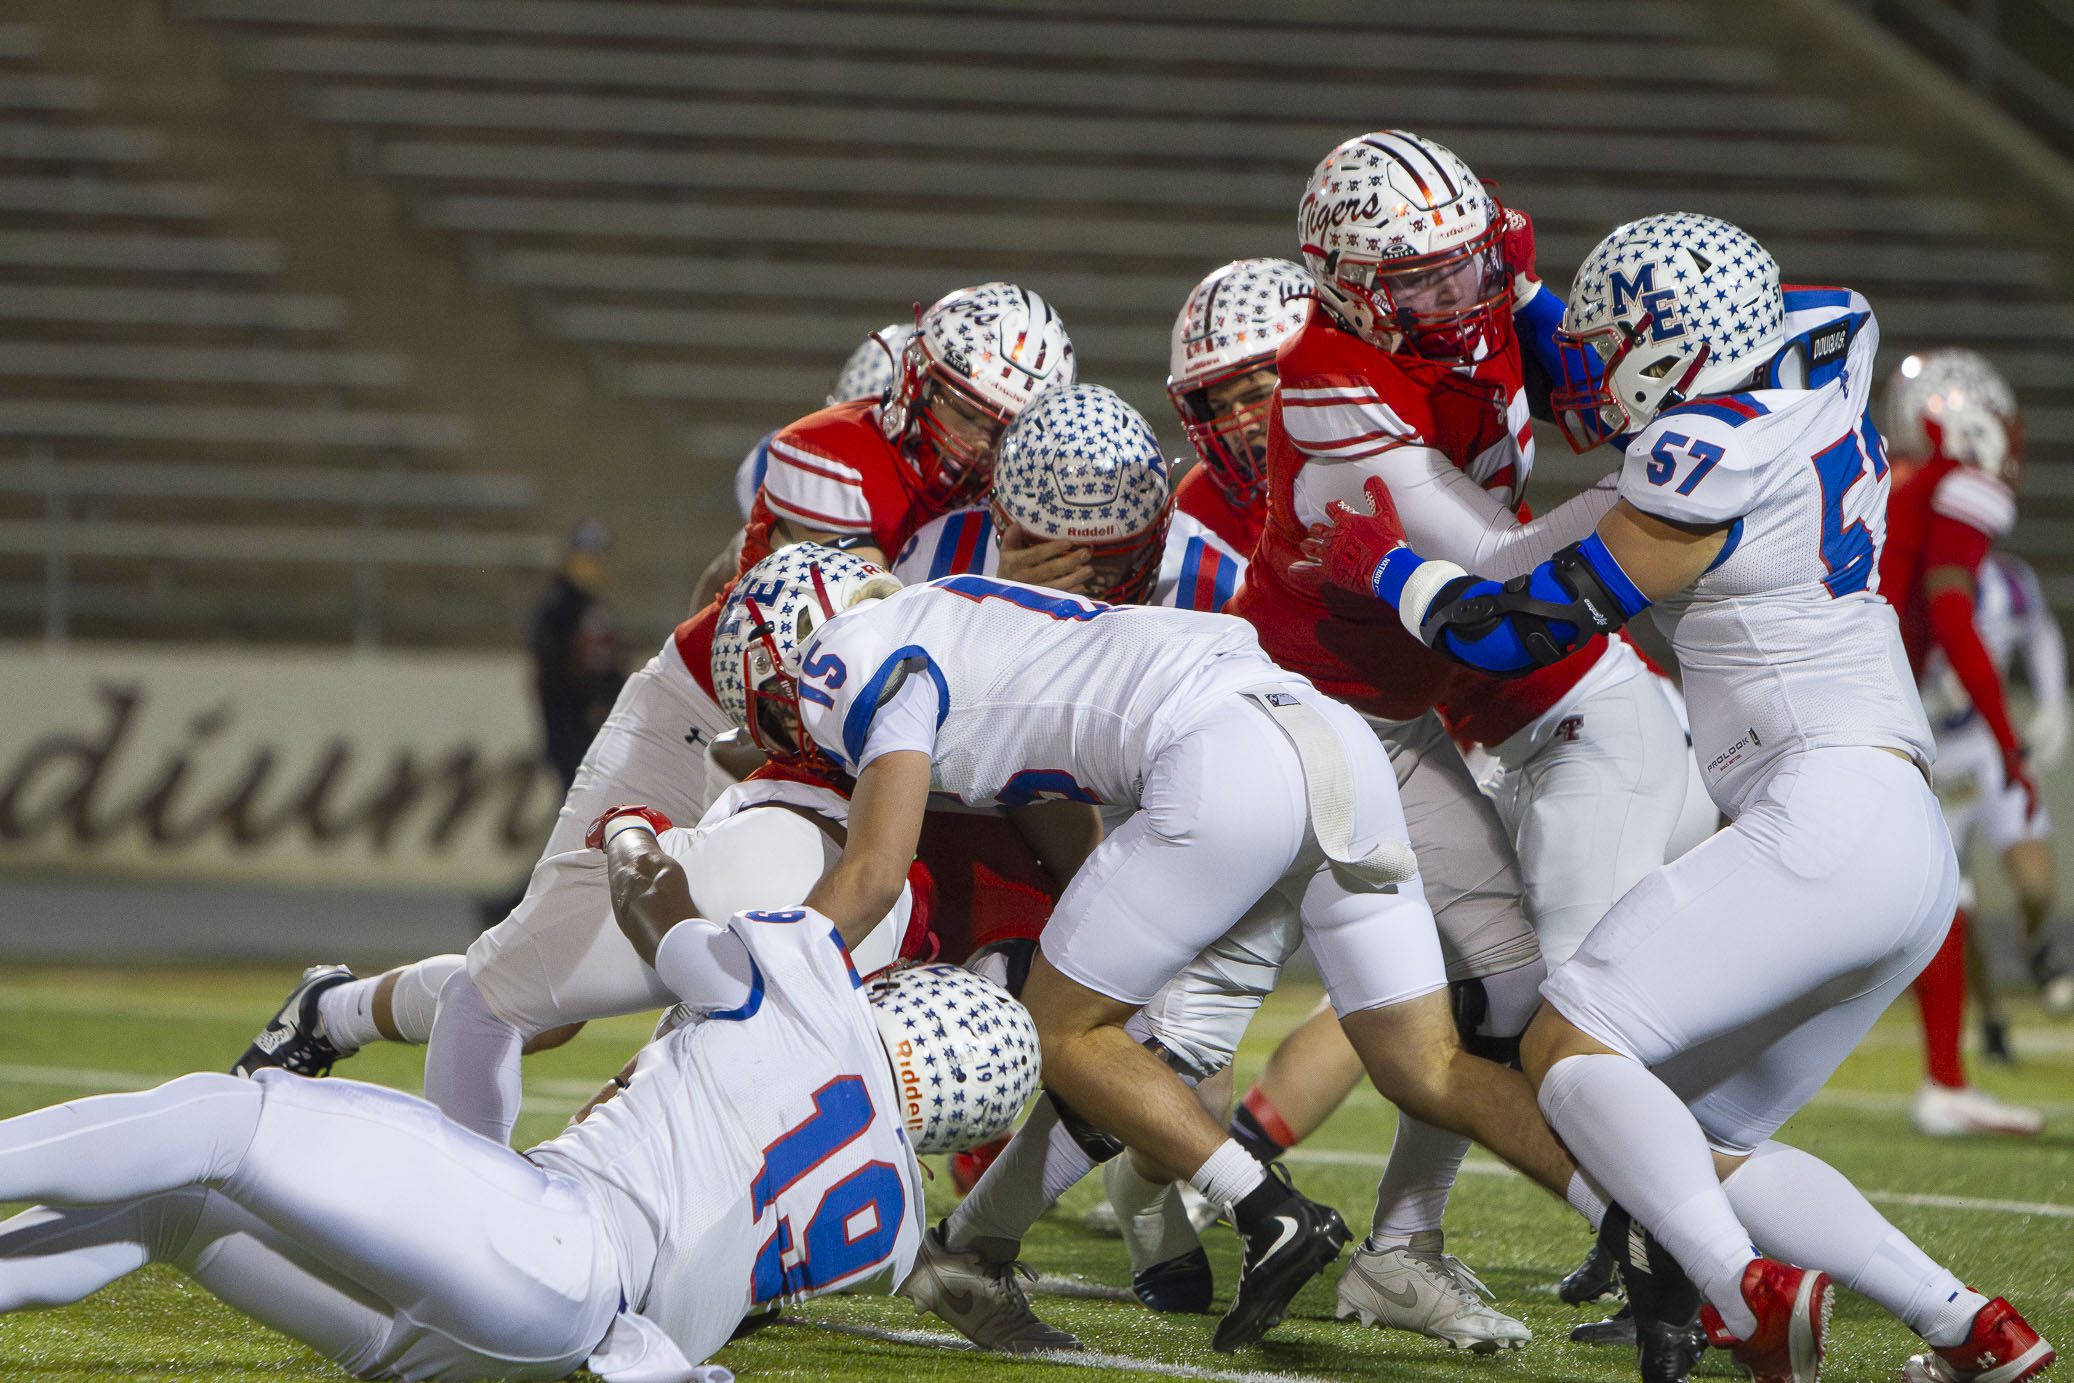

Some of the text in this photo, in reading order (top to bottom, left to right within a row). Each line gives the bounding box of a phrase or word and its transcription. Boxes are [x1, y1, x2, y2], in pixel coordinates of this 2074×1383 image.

[1300, 192, 1382, 248] Tigers
[1608, 259, 1688, 348] ME
[1646, 430, 1726, 497] 57
[1067, 525, 1115, 537] Riddell
[799, 639, 848, 712] 15
[1707, 737, 1750, 773] PROLOOK
[896, 1039, 923, 1132] Riddell
[975, 1062, 993, 1083] 19
[750, 1074, 906, 1306] 19
